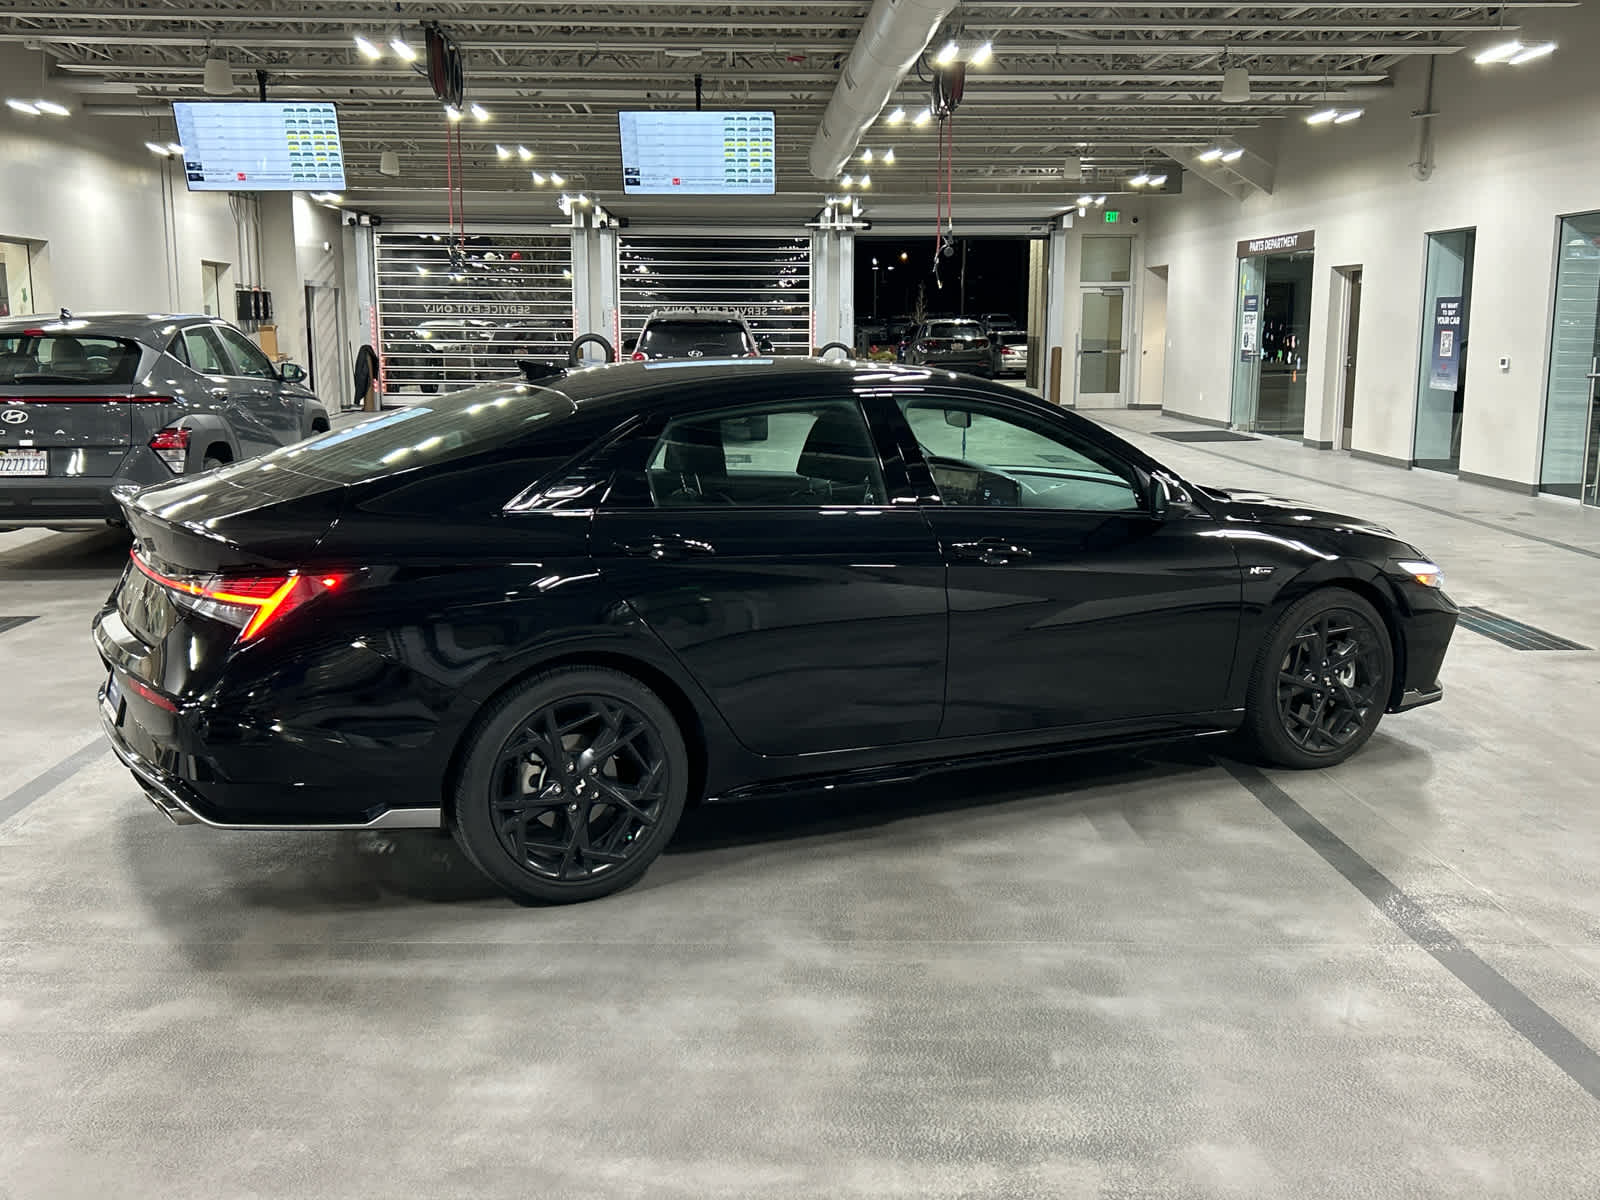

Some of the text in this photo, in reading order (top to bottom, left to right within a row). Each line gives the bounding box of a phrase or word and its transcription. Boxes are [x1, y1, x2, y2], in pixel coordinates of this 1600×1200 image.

[1105, 211, 1119, 223] EXIT
[1249, 235, 1298, 252] PARTS DEPARTMENT
